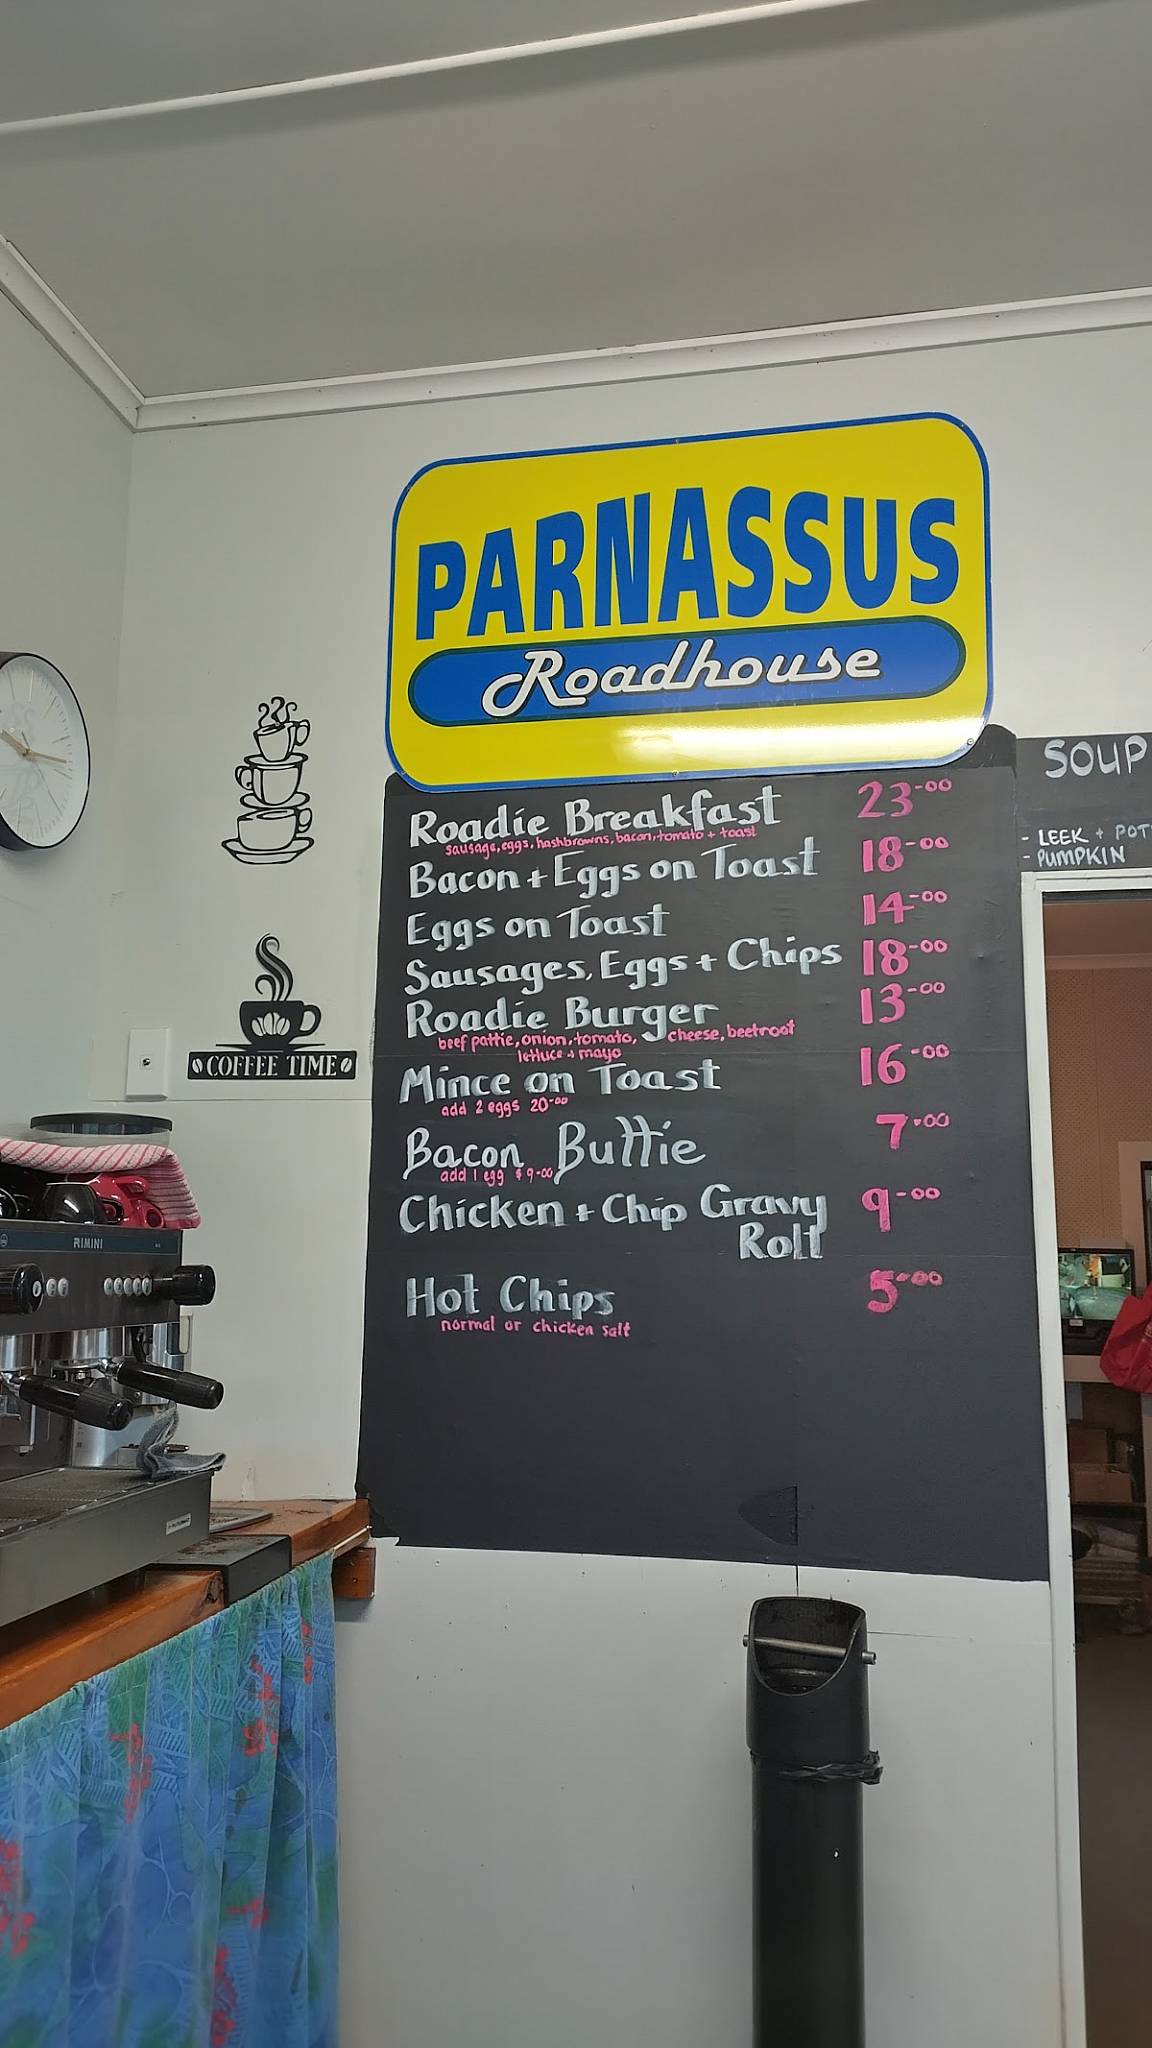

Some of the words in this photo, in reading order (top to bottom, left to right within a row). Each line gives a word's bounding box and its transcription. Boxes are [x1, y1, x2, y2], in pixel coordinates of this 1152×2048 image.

[416, 486, 959, 641] PARNASSUS
[480, 638, 882, 719] Roadhouse
[1044, 735, 1147, 778] SOUP
[410, 804, 550, 848] Roadie
[565, 785, 782, 837] Breakfast
[720, 826, 757, 838] toast
[1038, 827, 1089, 846] LEEK
[1096, 827, 1104, 839] +
[1115, 823, 1152, 840] POT
[409, 860, 520, 899] Bacon
[527, 867, 548, 888] +
[554, 850, 641, 899] Eggs
[650, 860, 698, 881] on
[701, 836, 820, 880] Toast
[1037, 845, 1126, 867] PUMPKIN
[407, 912, 496, 951] Eggs
[504, 915, 551, 938] on
[556, 904, 670, 939] Toast
[404, 958, 593, 995] Sausages,
[600, 950, 688, 990] Eggs
[696, 954, 717, 972] +
[727, 936, 843, 975] Chips
[406, 997, 550, 1038] Roadie
[564, 996, 720, 1042] Burger
[438, 1034, 467, 1052] beef
[727, 1018, 796, 1039] beetroot
[206, 1055, 278, 1077] COFFEE
[286, 1055, 338, 1076] TIME
[518, 1048, 562, 1064] lettuce
[579, 1047, 622, 1065] mayo
[399, 1064, 511, 1104] Mince
[524, 1070, 575, 1095] on
[587, 1058, 721, 1096] Toast
[441, 1101, 467, 1118] add
[475, 1099, 484, 1114] 2
[488, 1099, 520, 1118] eggs
[402, 1127, 525, 1180] Bacon
[553, 1114, 706, 1185] Buttie
[440, 1167, 466, 1182] add
[483, 1169, 504, 1187] egg
[399, 1194, 567, 1233] Chicken
[576, 1203, 595, 1222] +
[602, 1192, 688, 1232] Chip
[700, 1183, 827, 1235] Gravy
[73, 1237, 103, 1249] RIMINI
[406, 1273, 480, 1318] Hot
[500, 1275, 616, 1320] Chips
[441, 1315, 496, 1332] normal
[504, 1319, 522, 1332] or
[532, 1318, 594, 1336] chicken
[602, 1321, 631, 1338] salt
